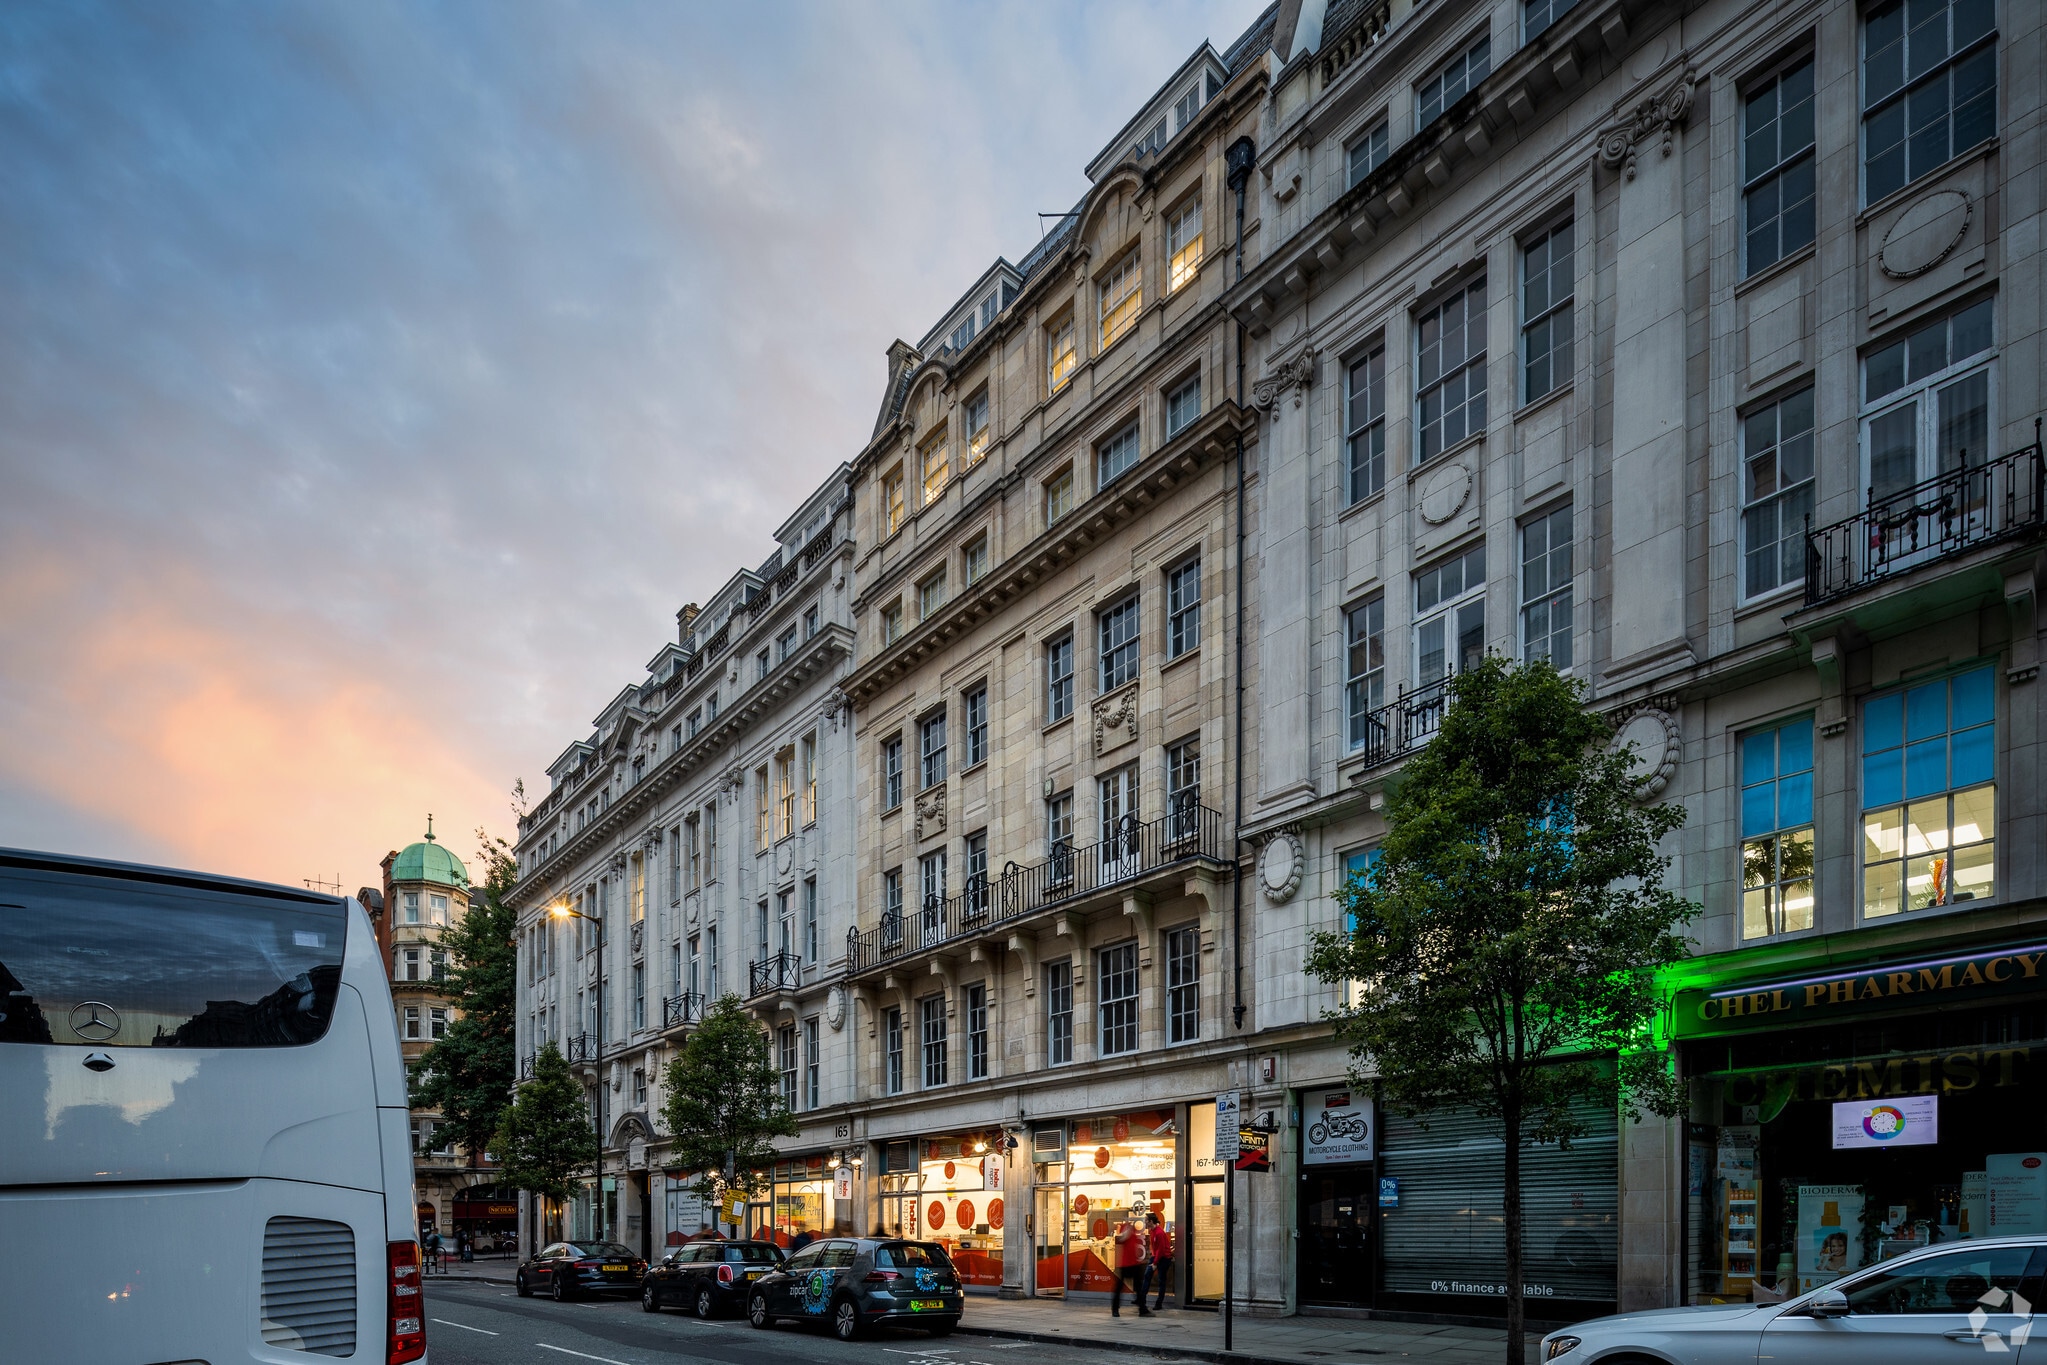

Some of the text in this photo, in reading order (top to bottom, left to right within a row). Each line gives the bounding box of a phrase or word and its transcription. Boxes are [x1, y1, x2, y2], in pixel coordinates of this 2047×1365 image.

[1697, 952, 2046, 1021] CHEL PHARMACY
[1725, 1047, 2030, 1106] CEMIST
[835, 1125, 848, 1138] 165
[1239, 1135, 1266, 1146] NFINITY
[1309, 1143, 1369, 1154] MOTORCYCLE CLOTHING
[1381, 1179, 1396, 1189] 0%
[1801, 1186, 1860, 1195] BIODERM
[1961, 1193, 1986, 1201] oderm
[789, 1284, 808, 1298] zipcar
[1431, 1281, 1553, 1296] 0% finance alable
